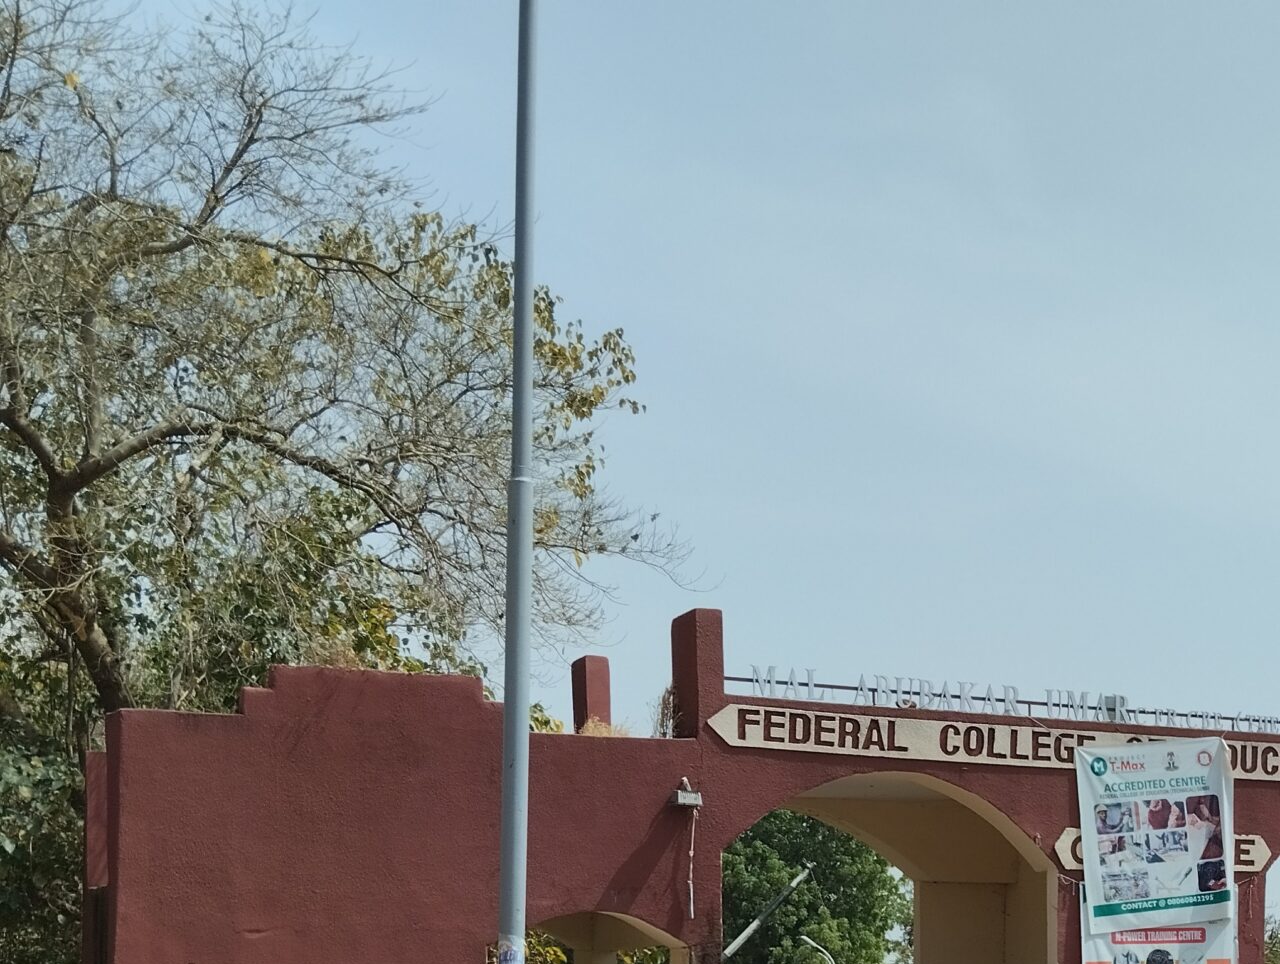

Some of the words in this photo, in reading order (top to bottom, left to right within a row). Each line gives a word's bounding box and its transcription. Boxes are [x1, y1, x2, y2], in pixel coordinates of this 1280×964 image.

[853, 673, 1021, 716] ABUBAKAR
[1044, 688, 1132, 724] UMAR
[737, 707, 908, 752] FEDERAL
[1110, 760, 1146, 771] T-Max
[1104, 779, 1166, 793] ACCREDITED
[1169, 775, 1207, 788] CENTRE
[1121, 900, 1158, 911] CONTACT
[1147, 930, 1177, 941] TRAINING
[1178, 930, 1202, 941] CENTRE
